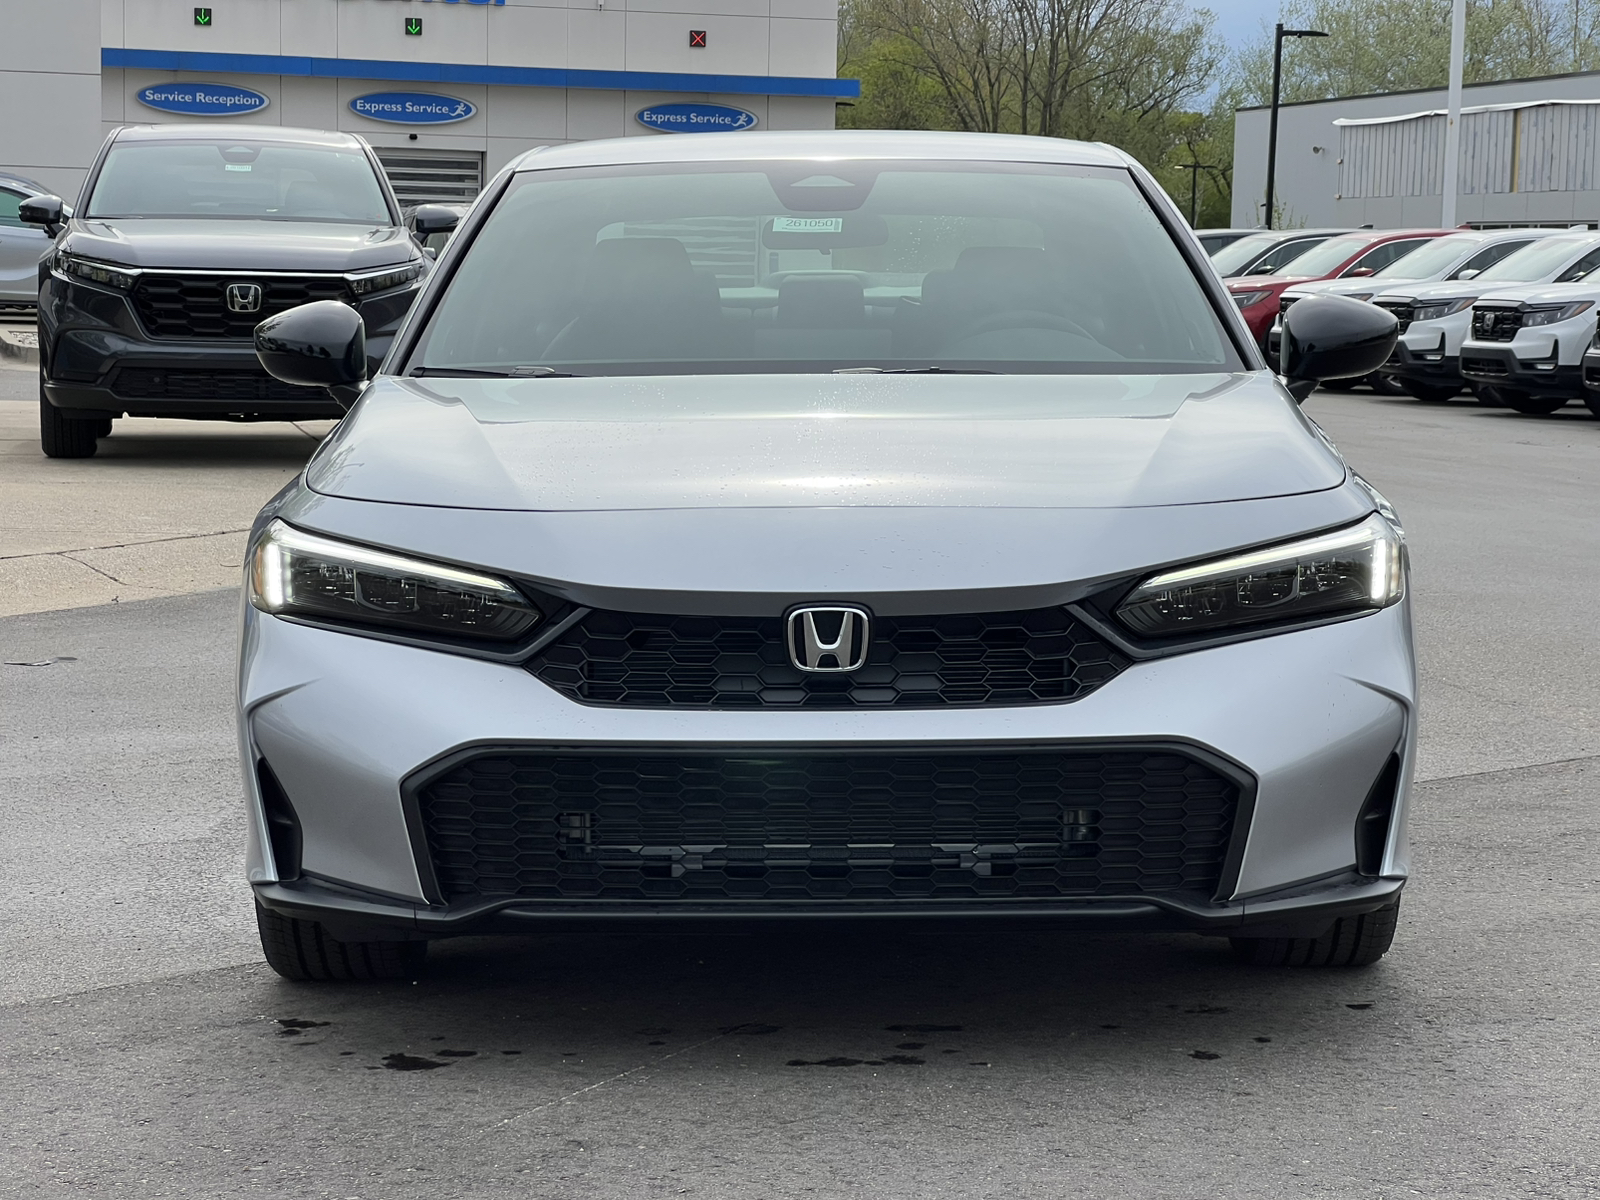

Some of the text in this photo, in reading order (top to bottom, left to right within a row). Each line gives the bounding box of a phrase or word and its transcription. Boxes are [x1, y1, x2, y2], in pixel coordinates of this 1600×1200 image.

[145, 90, 260, 106] Service Reception
[356, 100, 449, 114] Express Service
[643, 111, 732, 124] Express Service
[785, 219, 834, 227] 261050
